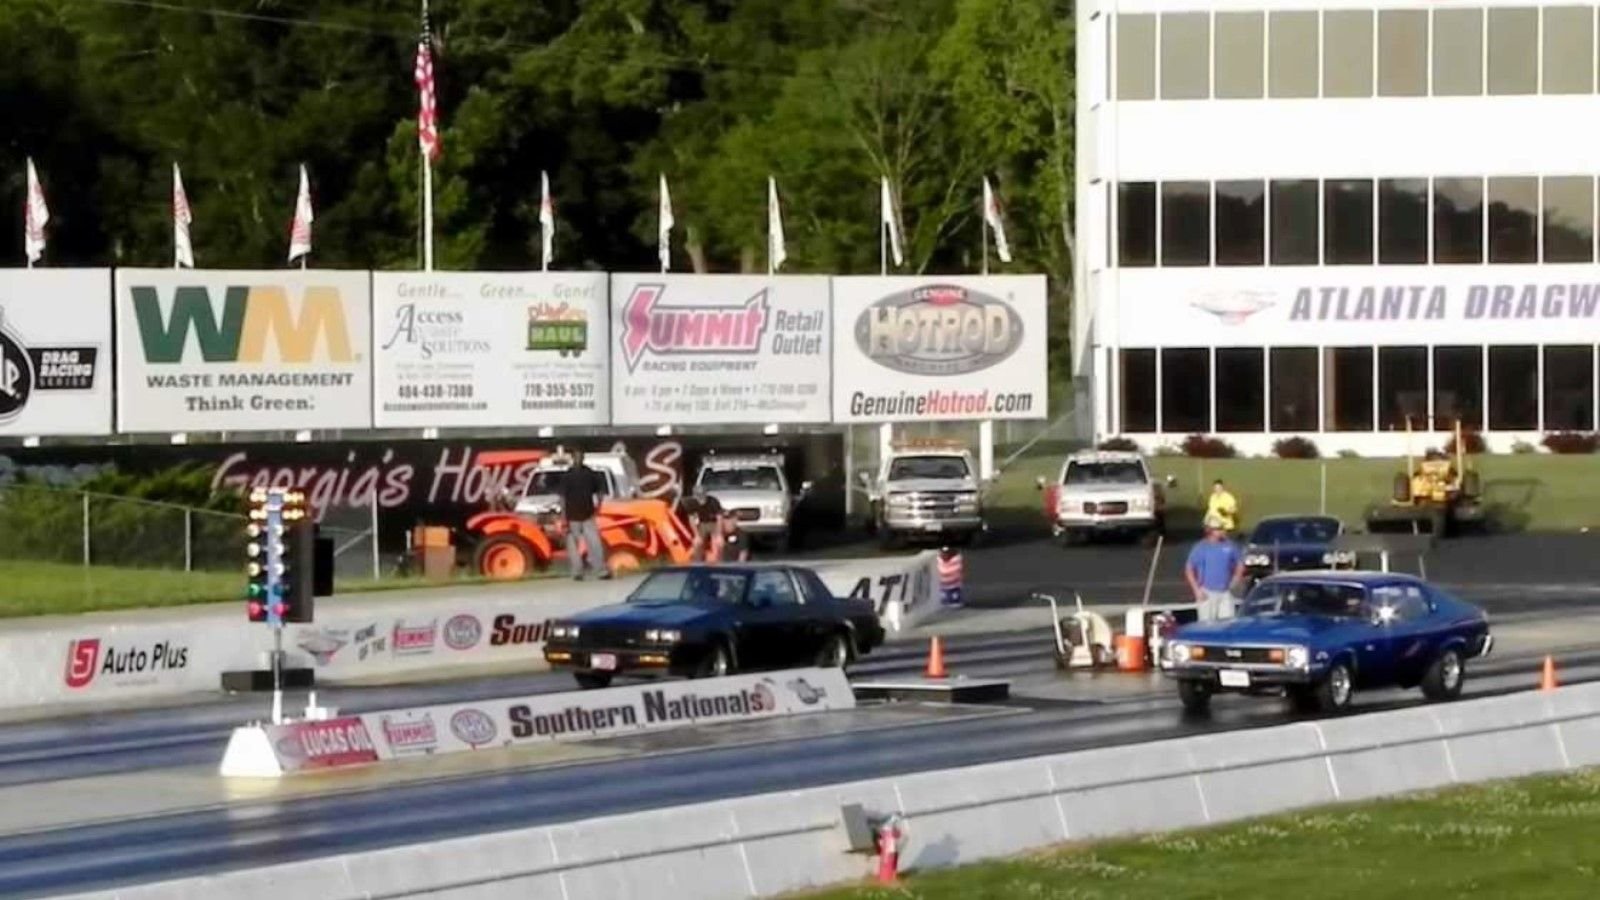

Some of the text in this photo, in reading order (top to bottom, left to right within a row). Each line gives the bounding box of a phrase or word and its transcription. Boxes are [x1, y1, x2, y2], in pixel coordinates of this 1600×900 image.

[1289, 286, 1447, 321] ATLANTA
[130, 286, 353, 363] WM
[382, 302, 463, 350] Access
[775, 310, 824, 331] Retail
[869, 304, 1011, 355] HOTROD
[531, 325, 584, 342] HAUL
[772, 333, 822, 354] Outlet
[41, 350, 79, 363] DRAG
[643, 360, 757, 371] RACING EQUIPMENT
[40, 363, 92, 376] RACING
[147, 373, 354, 388] WASTE MANAGEMENT
[40, 377, 87, 388] SERIES
[185, 395, 244, 411] Think
[850, 389, 1032, 416] GenuineHotrod.com
[211, 448, 413, 523] Georgia's
[101, 640, 188, 674] Auto Plus
[508, 703, 637, 738] Southern
[641, 687, 763, 723] Nationals
[301, 725, 373, 756] LUCAS OIL
